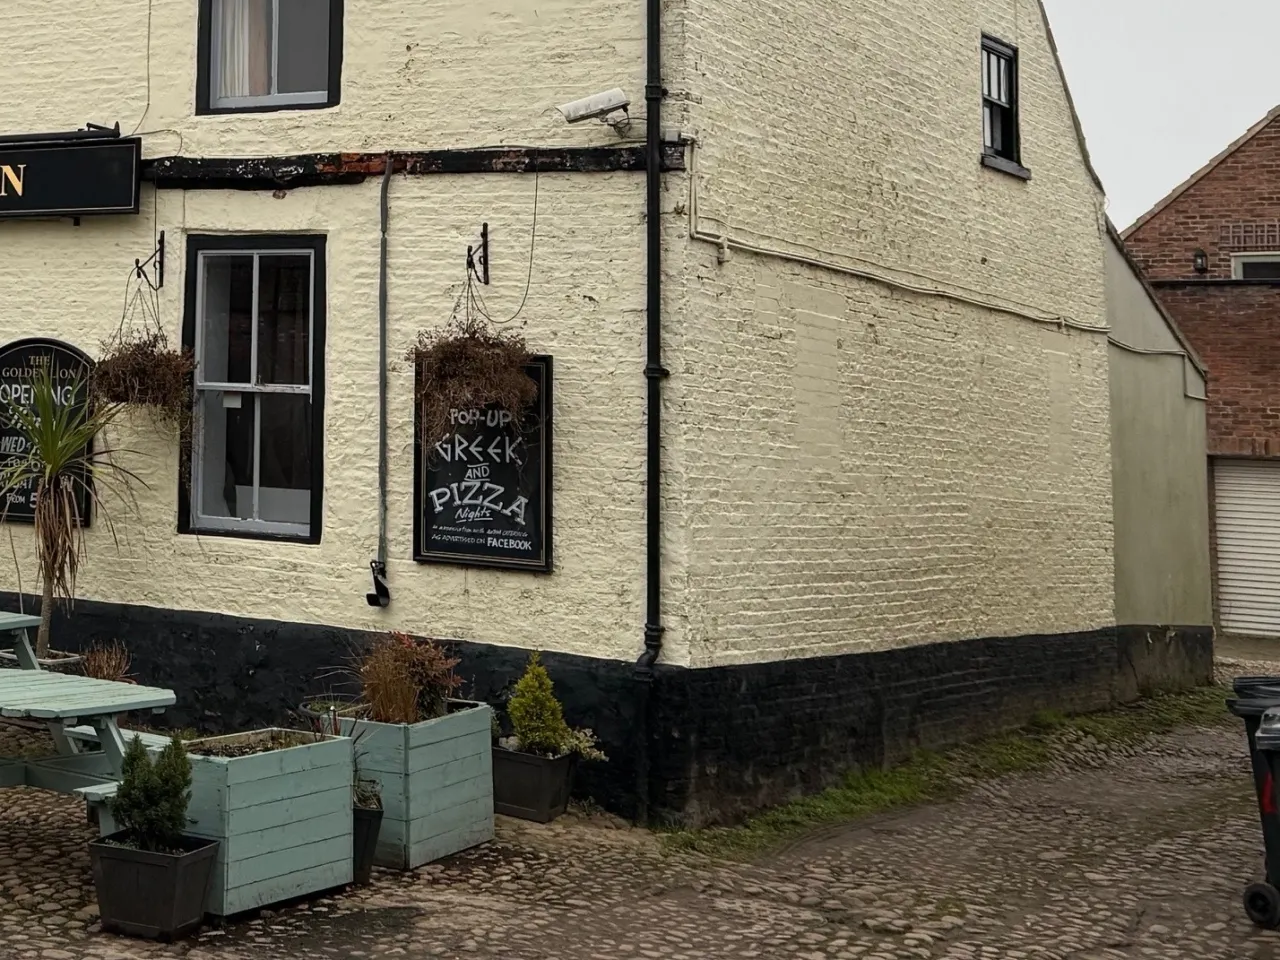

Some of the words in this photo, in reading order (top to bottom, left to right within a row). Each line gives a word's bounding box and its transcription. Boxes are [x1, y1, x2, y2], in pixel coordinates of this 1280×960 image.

[28, 355, 51, 366] THE
[449, 408, 512, 428] POP-UP
[1, 436, 25, 453] WED
[435, 434, 523, 465] GREEK
[465, 465, 490, 479] AND
[6, 493, 25, 504] FROM
[429, 481, 529, 525] PIZZA
[455, 506, 492, 522] Nights
[487, 537, 532, 551] FACEBOOK
